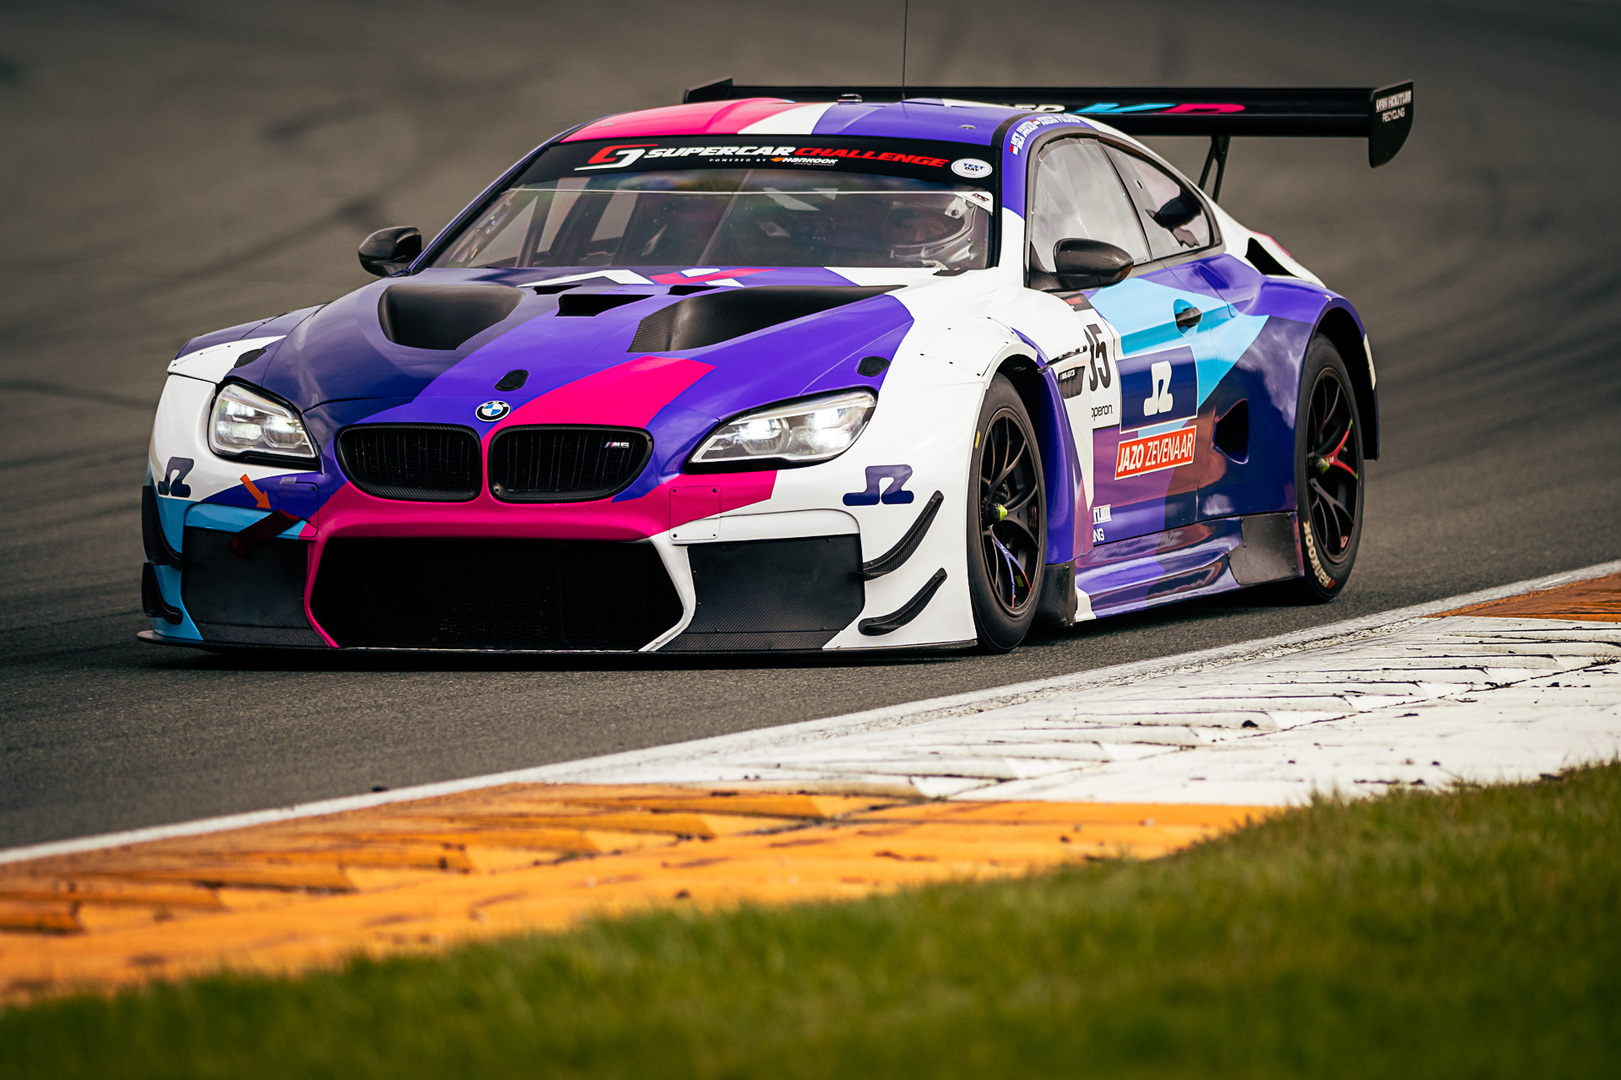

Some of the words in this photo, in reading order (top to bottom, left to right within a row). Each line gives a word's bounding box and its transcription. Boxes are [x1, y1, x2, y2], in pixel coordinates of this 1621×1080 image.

[644, 146, 796, 158] SUPERCAR
[794, 147, 950, 168] CHALLENGE
[1118, 444, 1145, 473] JAZO
[1145, 433, 1194, 467] ZEVENAAR
